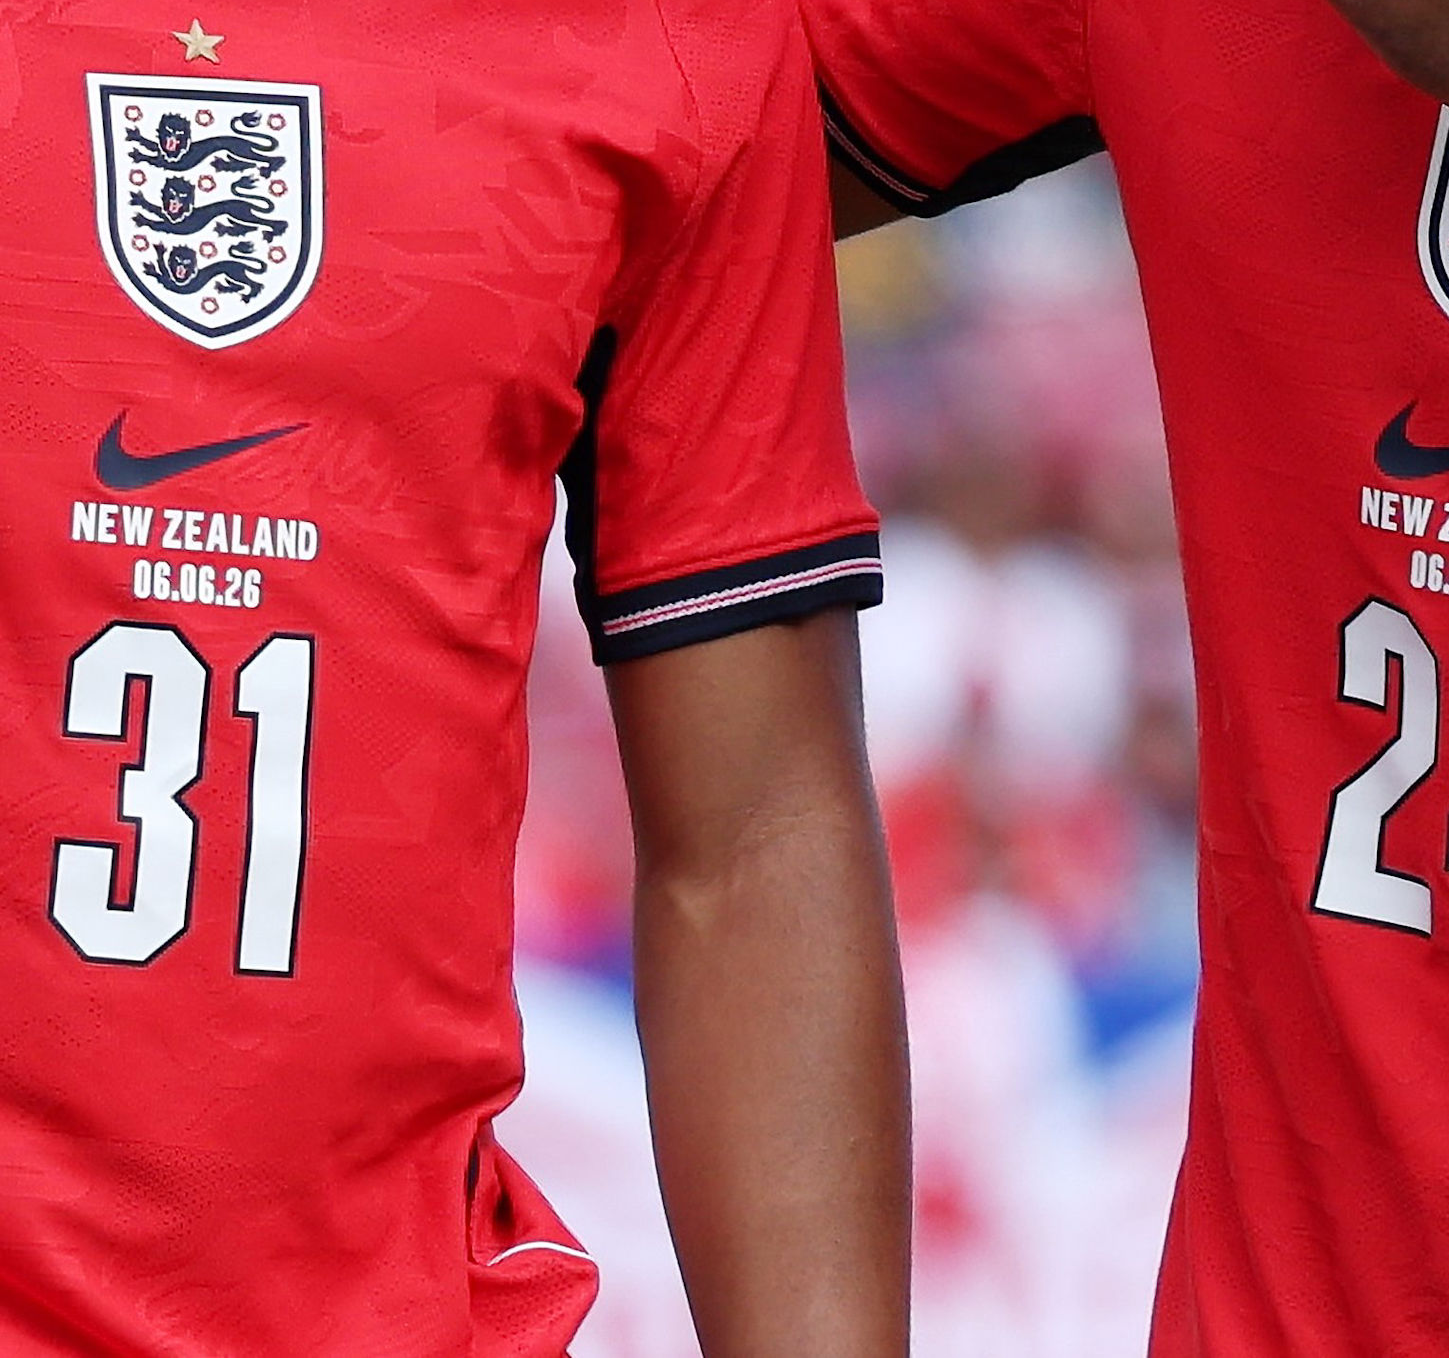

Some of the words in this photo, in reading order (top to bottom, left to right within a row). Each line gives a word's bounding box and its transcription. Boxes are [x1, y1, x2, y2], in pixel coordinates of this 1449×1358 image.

[71, 501, 154, 548] NEW
[162, 508, 319, 561] ZEALAND
[1360, 487, 1436, 537] NEW
[133, 559, 262, 608] 06.06.26
[50, 620, 316, 978] 31
